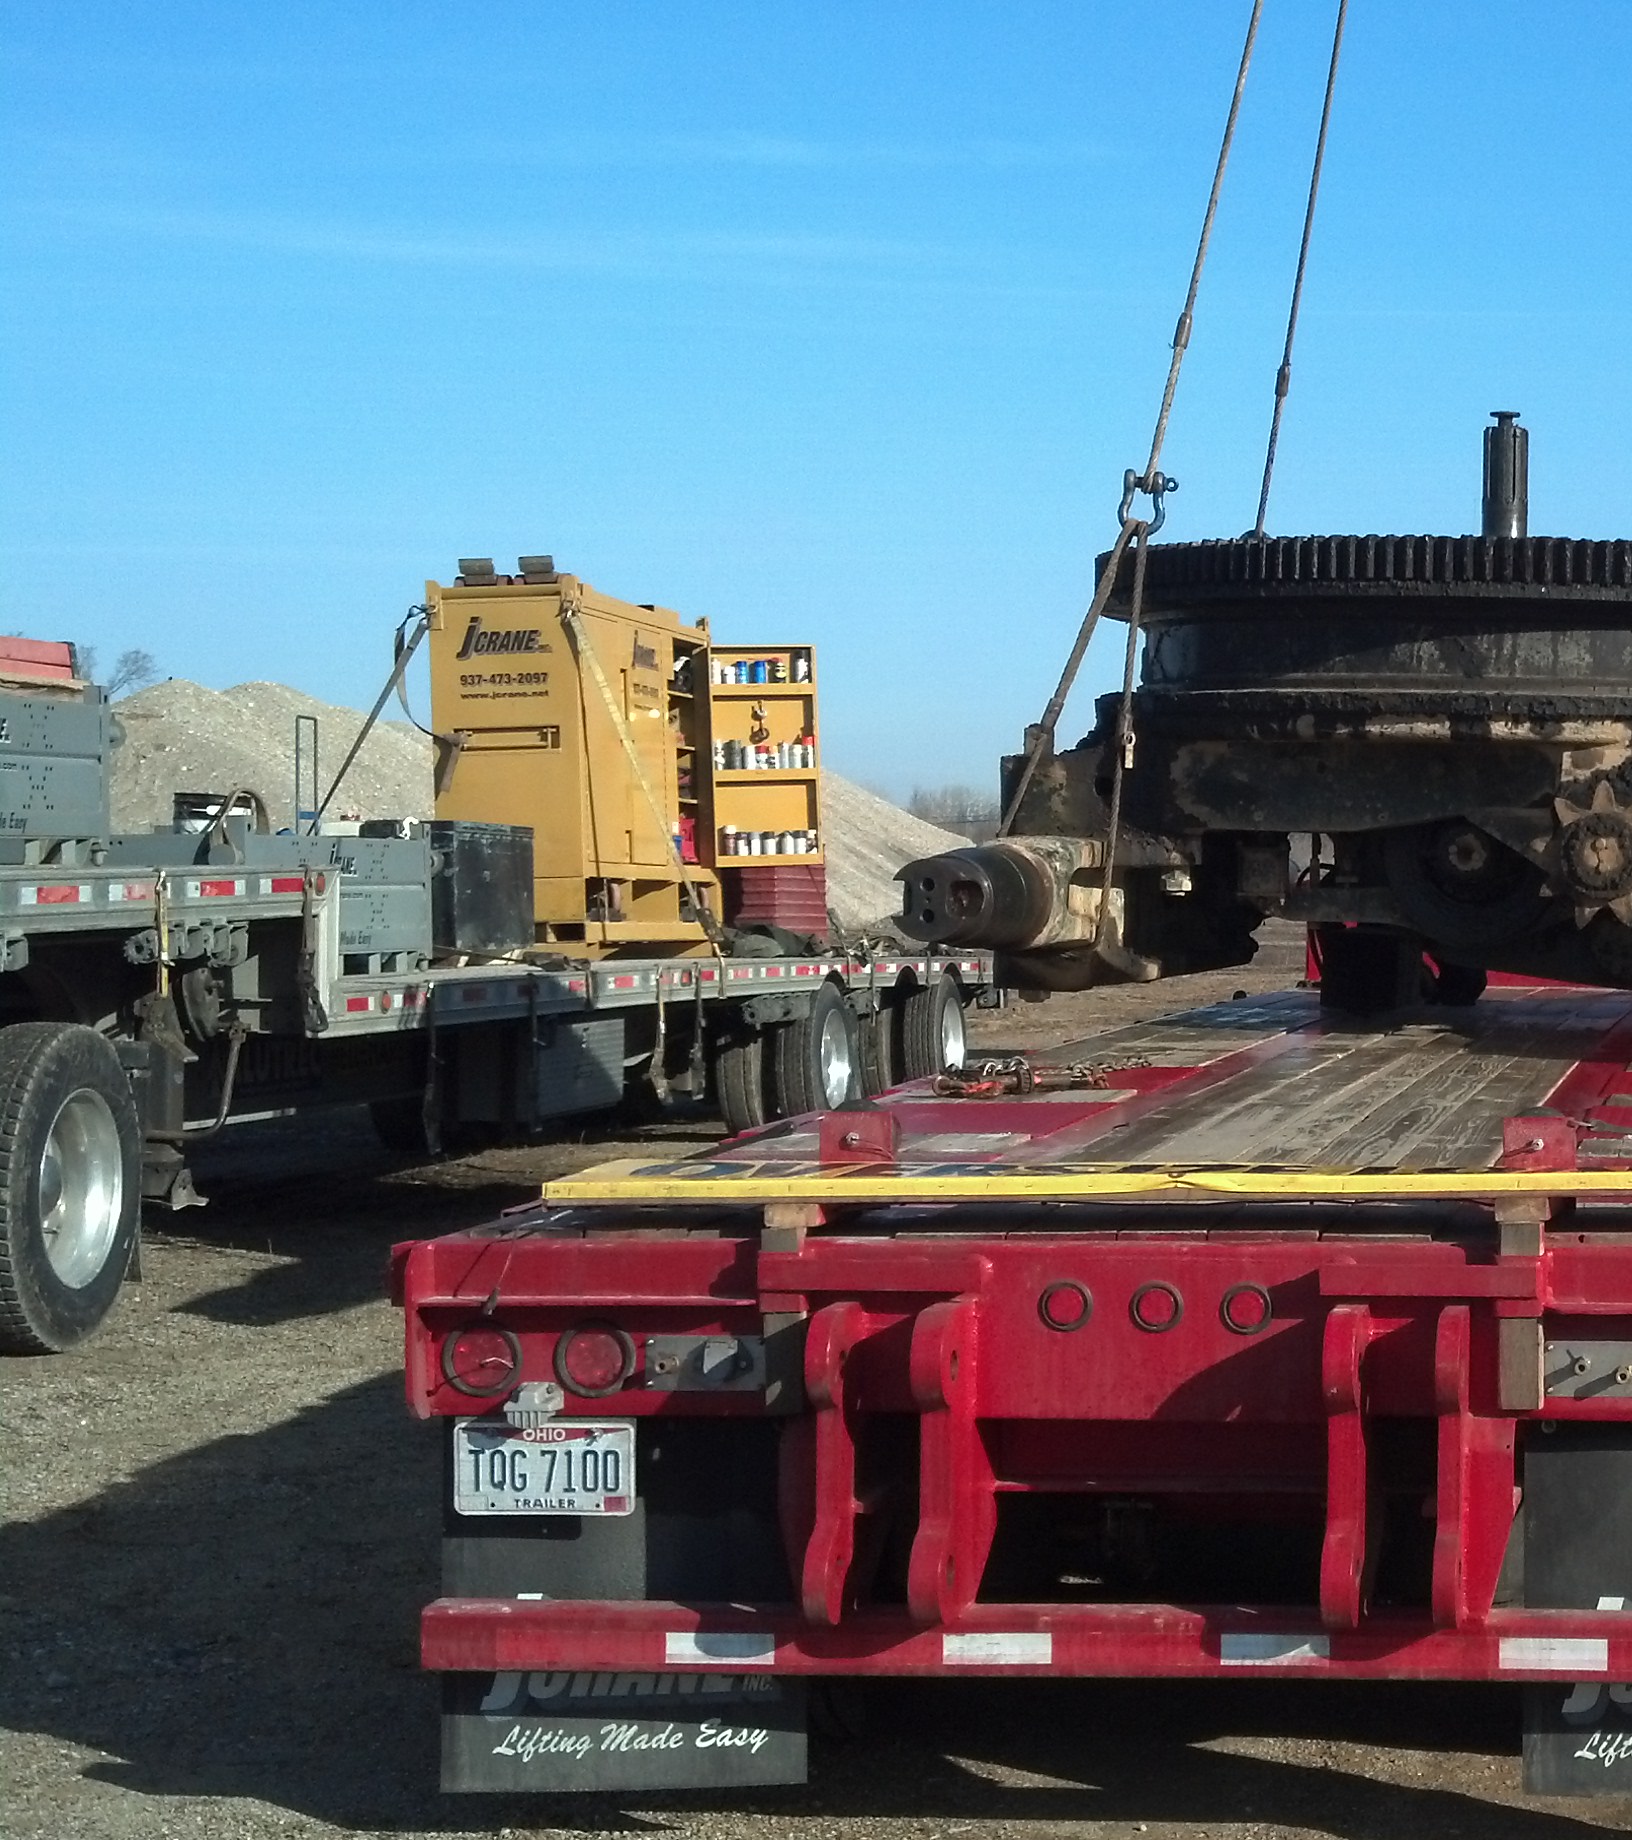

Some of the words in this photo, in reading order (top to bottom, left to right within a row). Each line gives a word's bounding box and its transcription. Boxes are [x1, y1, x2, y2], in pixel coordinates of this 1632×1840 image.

[460, 672, 548, 687] 937-473-2097
[522, 1428, 566, 1442] OHIO
[468, 1449, 528, 1493] TQG
[540, 1449, 621, 1493] 7100
[514, 1498, 577, 1509] TRAILER
[492, 1725, 594, 1762] Lifting
[600, 1723, 683, 1752] Made
[695, 1718, 769, 1753] Easy
